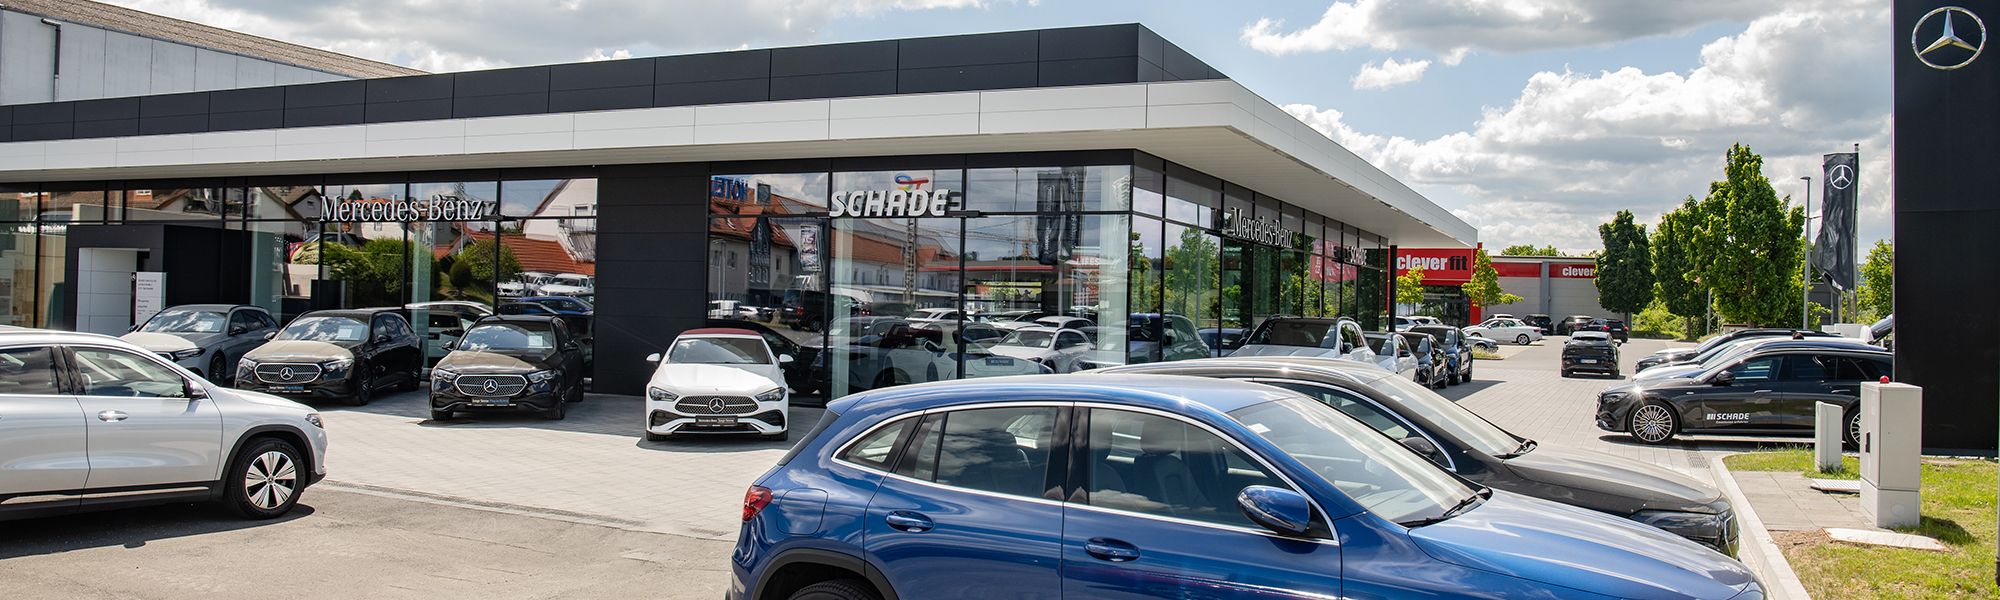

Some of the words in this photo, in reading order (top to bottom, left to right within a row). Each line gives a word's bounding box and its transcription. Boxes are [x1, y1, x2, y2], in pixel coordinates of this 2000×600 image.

[320, 194, 482, 222] Mercedes-Benz
[829, 189, 948, 217] SCHADE
[1232, 207, 1293, 249] Mercedes-Benz
[1397, 255, 1447, 271] clever
[1450, 256, 1468, 271] fit
[1562, 266, 1595, 277] clever
[1716, 412, 1750, 420] SCHADE
